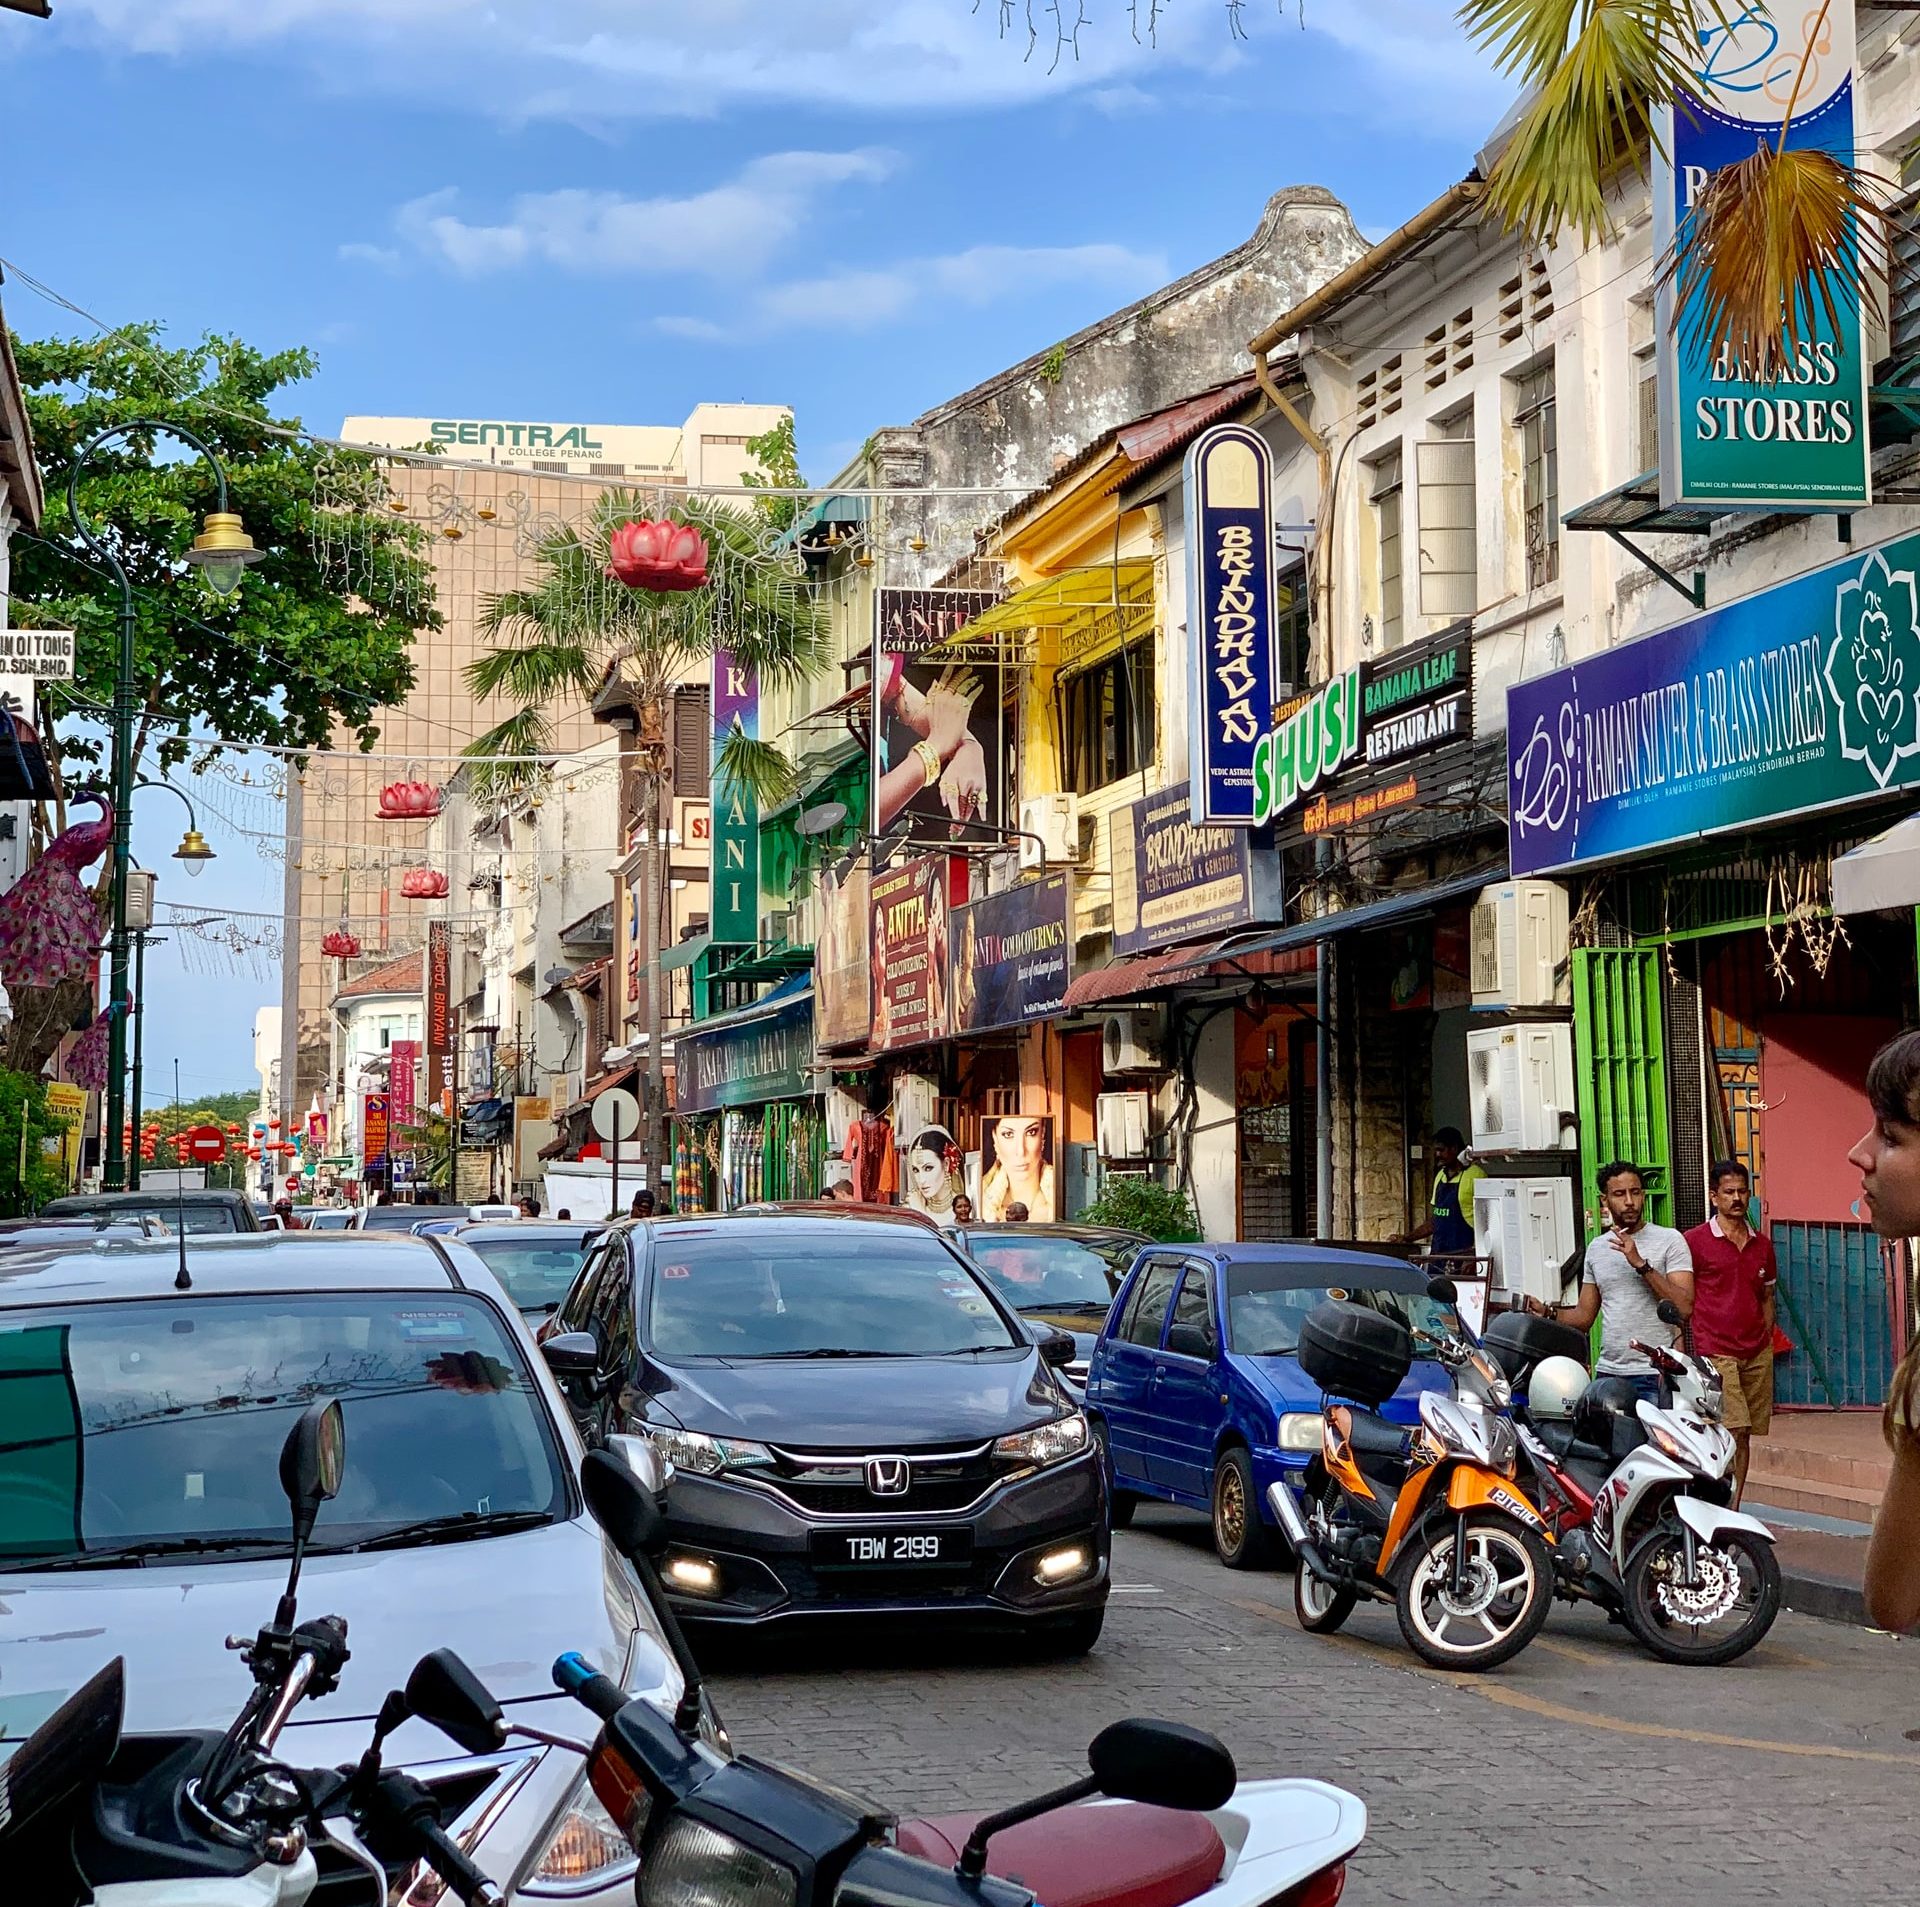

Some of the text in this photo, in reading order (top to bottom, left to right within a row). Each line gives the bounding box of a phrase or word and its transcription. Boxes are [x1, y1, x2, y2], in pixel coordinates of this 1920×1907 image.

[1710, 340, 1839, 386] BSS
[431, 422, 602, 448] SENTRAL
[1696, 397, 1855, 443] STORES
[508, 447, 602, 458] COLLEGE PENANG
[34, 636, 71, 656] TONG
[883, 640, 918, 652] GOLD
[886, 609, 993, 641] ANIT
[1213, 525, 1259, 743] BRINDHAVAN
[1365, 650, 1456, 714] BANANA LEAF
[1366, 702, 1457, 763] RESTAURANT
[1584, 633, 1827, 803] RAMANI SILVER & BRASS STORES
[1253, 664, 1361, 827] SHUSI
[1210, 768, 1228, 776] VEDIC
[1694, 775, 1718, 789] STORES
[1757, 756, 1796, 774] SENDIRIAN
[1796, 746, 1826, 764] BERHAD
[724, 667, 748, 912] RAANI
[692, 817, 709, 838] S
[887, 895, 926, 945] ANITA
[1492, 1489, 1539, 1525] PJT2110
[846, 1536, 939, 1559] TBW 2199
